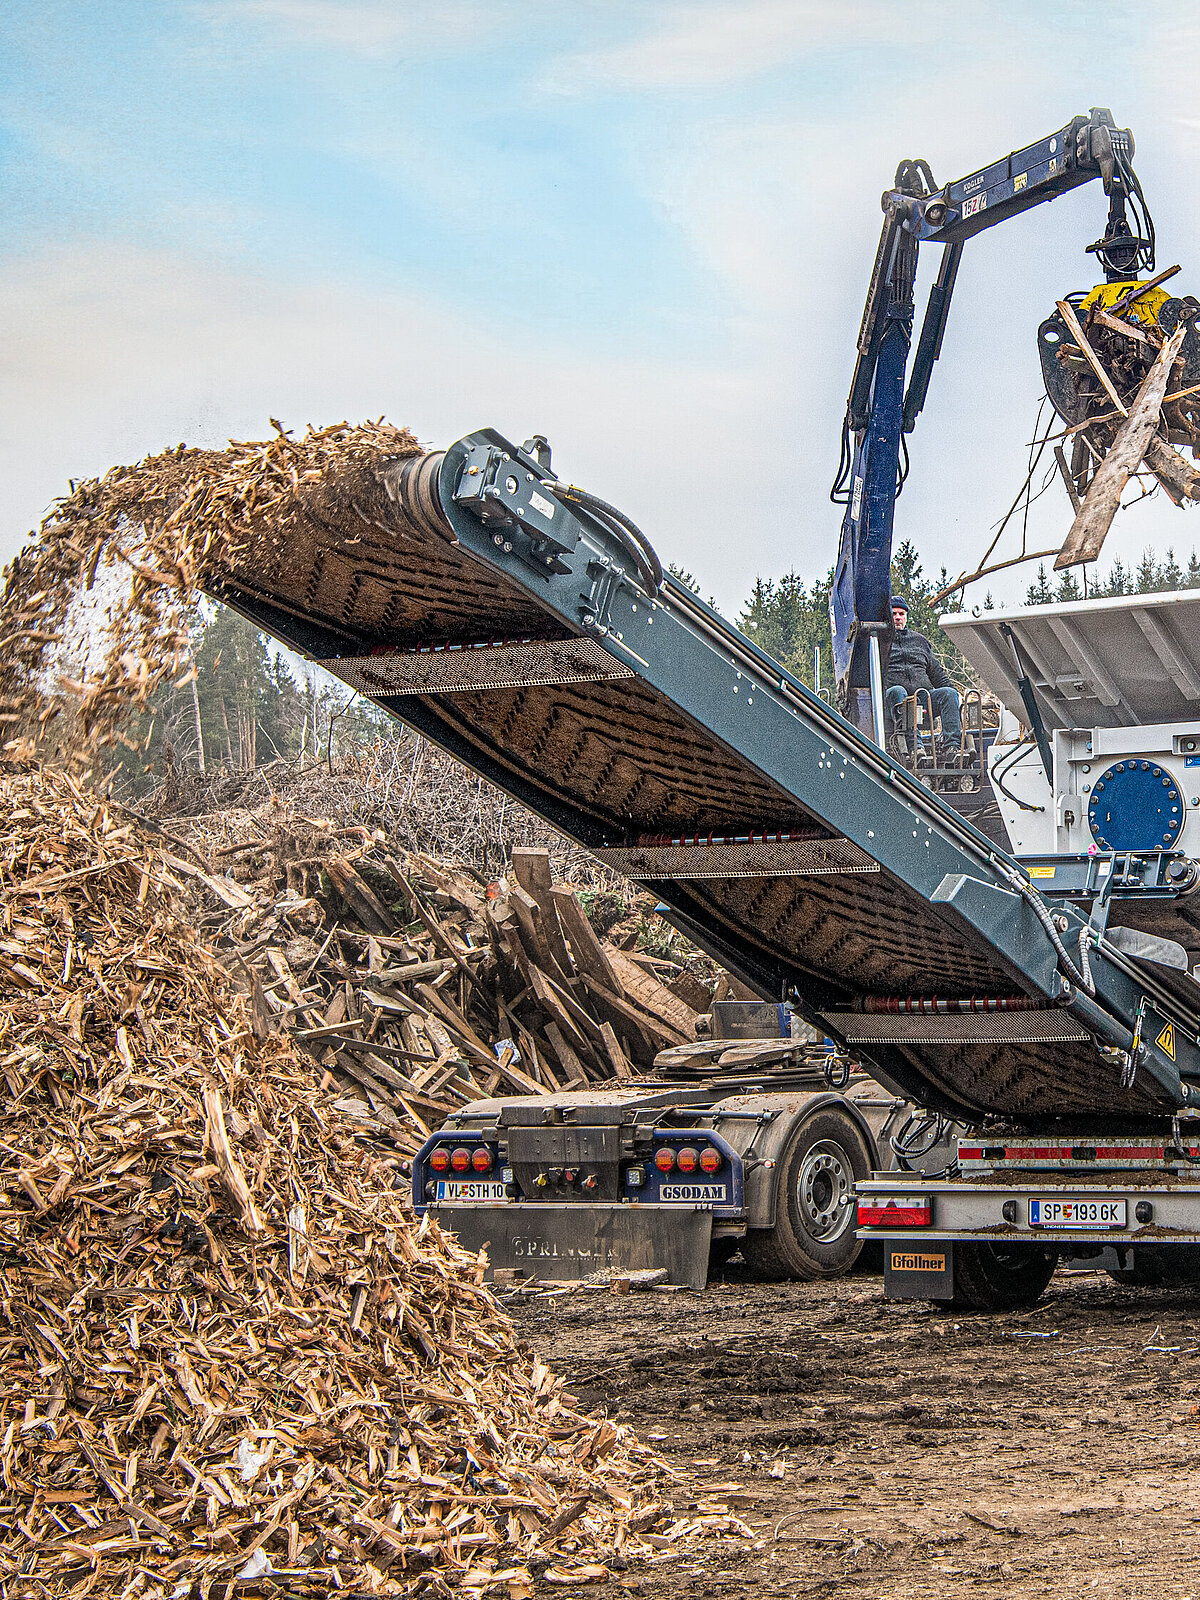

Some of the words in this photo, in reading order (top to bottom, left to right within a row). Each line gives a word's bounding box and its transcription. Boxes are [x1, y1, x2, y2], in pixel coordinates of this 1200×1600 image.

[448, 1183, 460, 1198] VL
[469, 1183, 489, 1198] STH
[491, 1183, 503, 1198] 10
[662, 1186, 723, 1199] GSODAM
[1044, 1203, 1061, 1221] SP
[1073, 1203, 1097, 1221] 193
[1100, 1203, 1118, 1221] GK
[515, 1239, 619, 1257] SPRIGR
[892, 1254, 944, 1269] Gföllner
